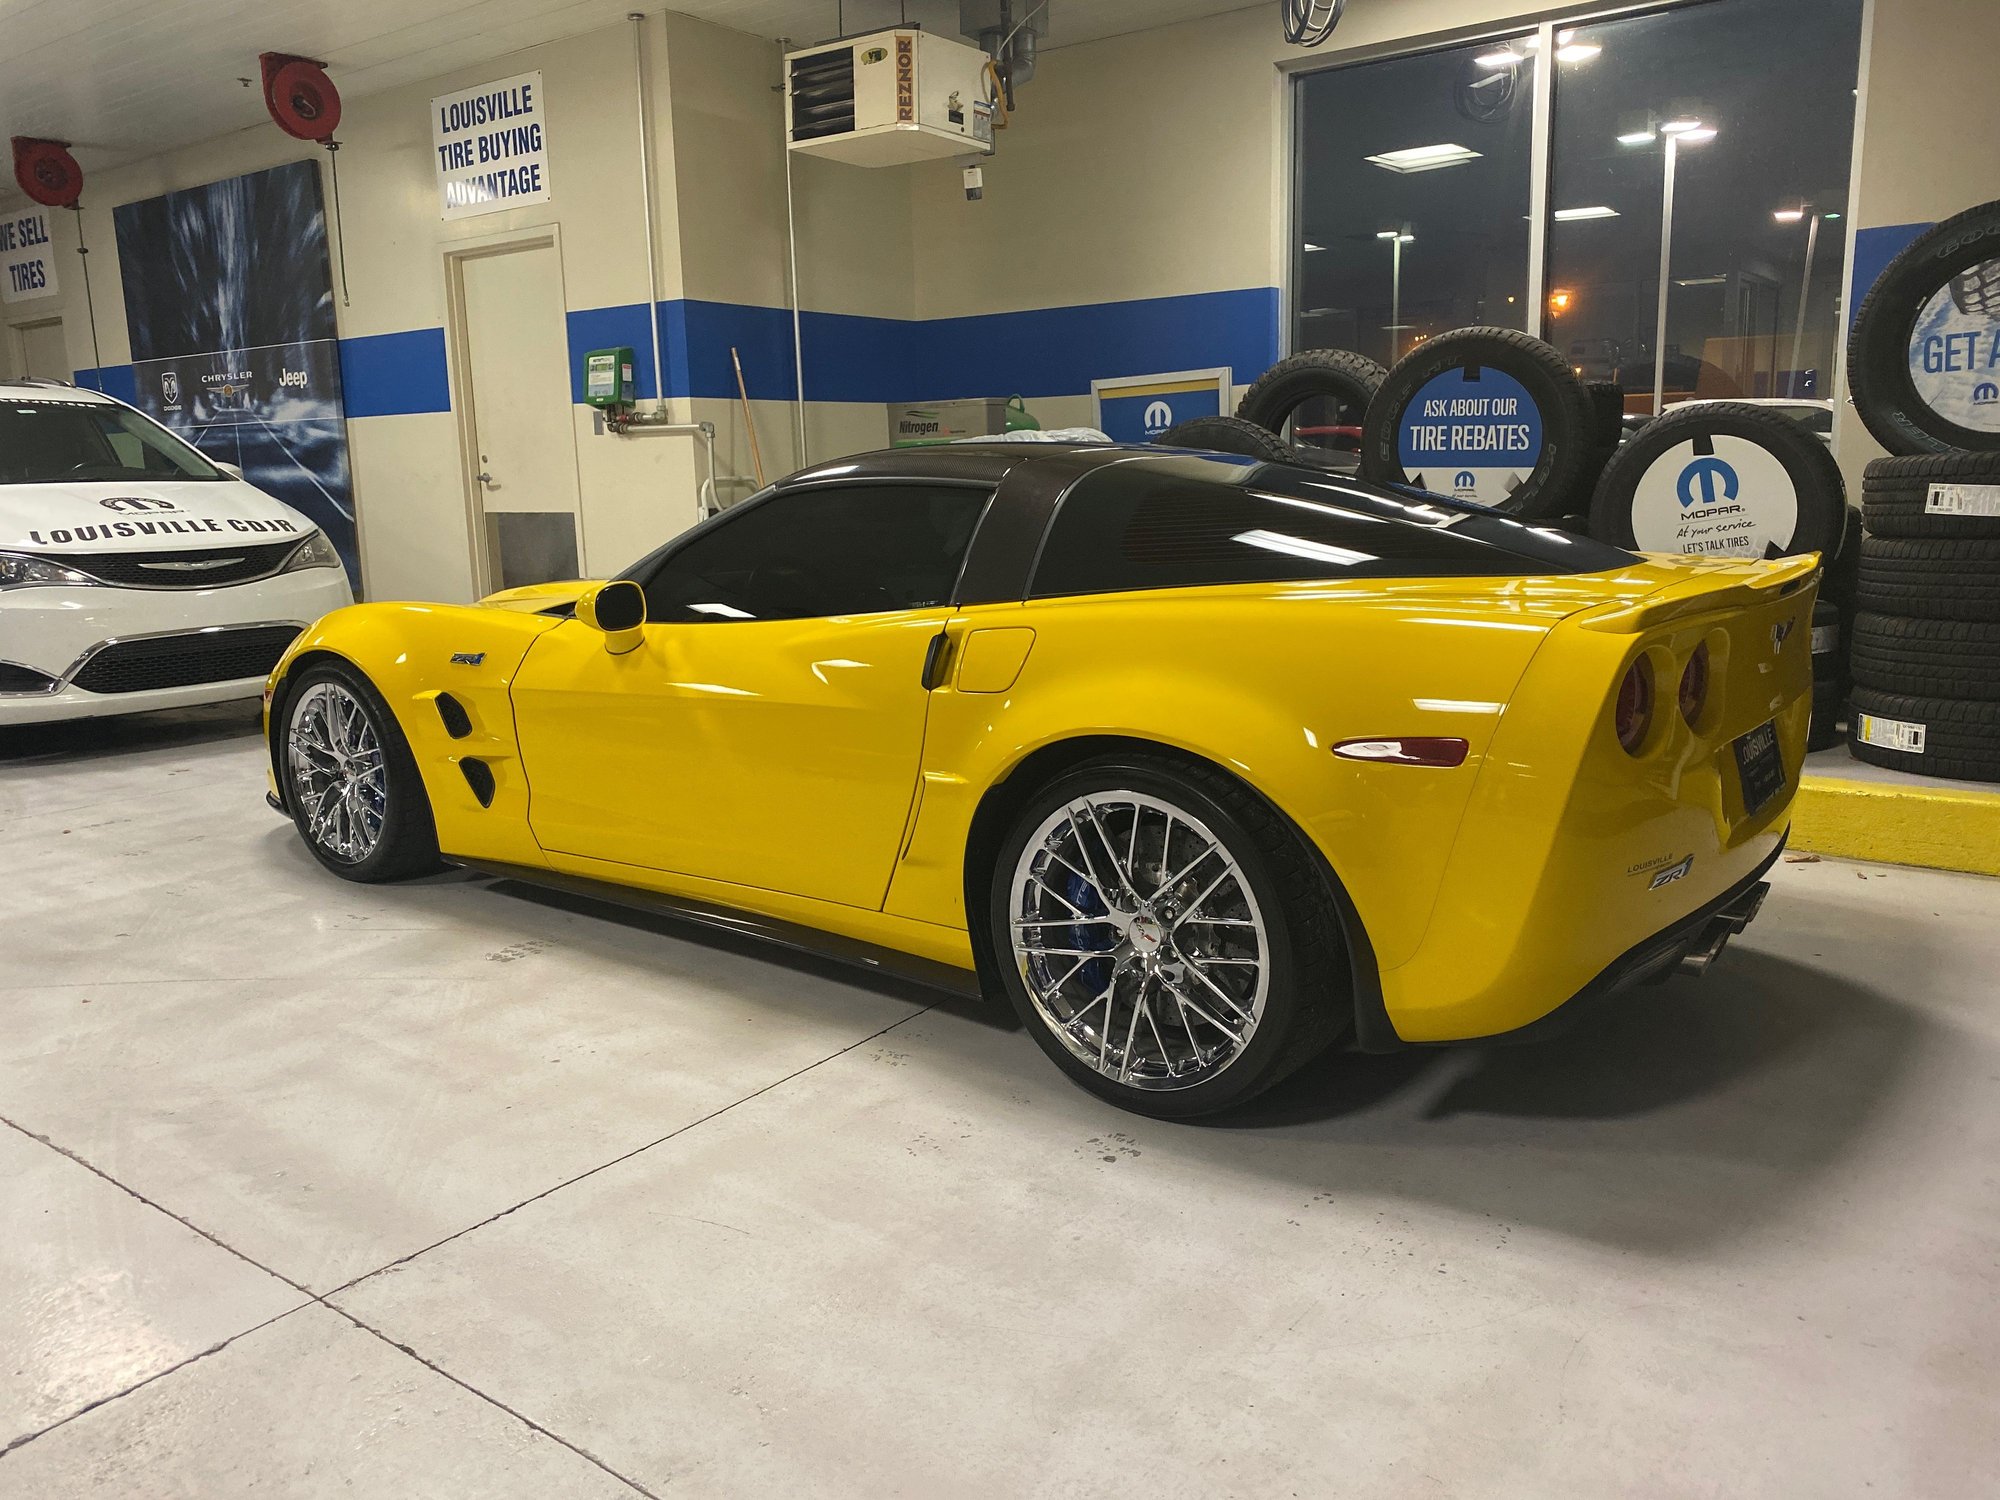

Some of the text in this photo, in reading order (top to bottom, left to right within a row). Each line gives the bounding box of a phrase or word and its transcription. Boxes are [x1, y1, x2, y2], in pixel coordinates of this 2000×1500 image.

[899, 39, 912, 121] REZNOR
[441, 84, 533, 134] LOUISVILLE
[438, 123, 542, 172] TIRE BUYING
[446, 164, 542, 209] ADVANTAGE
[18, 215, 49, 248] SELL
[9, 259, 46, 293] TIRES
[1923, 331, 1982, 374] GET
[201, 371, 253, 383] CHRYSLER
[279, 368, 308, 389] Jeep
[1424, 398, 1517, 417] ASK ABOUT OUR
[899, 421, 939, 435] Nitrogen
[1410, 424, 1530, 451] TIRE REBATES
[1680, 504, 1742, 521] MOPAR
[29, 518, 298, 545] LOUISVILLE CDJR
[1676, 518, 1757, 539] At your service
[1683, 535, 1749, 554] LET'S TALK TIRES
[1627, 853, 1674, 873] LOUISVILLE
[1649, 853, 1695, 890] ZR1
